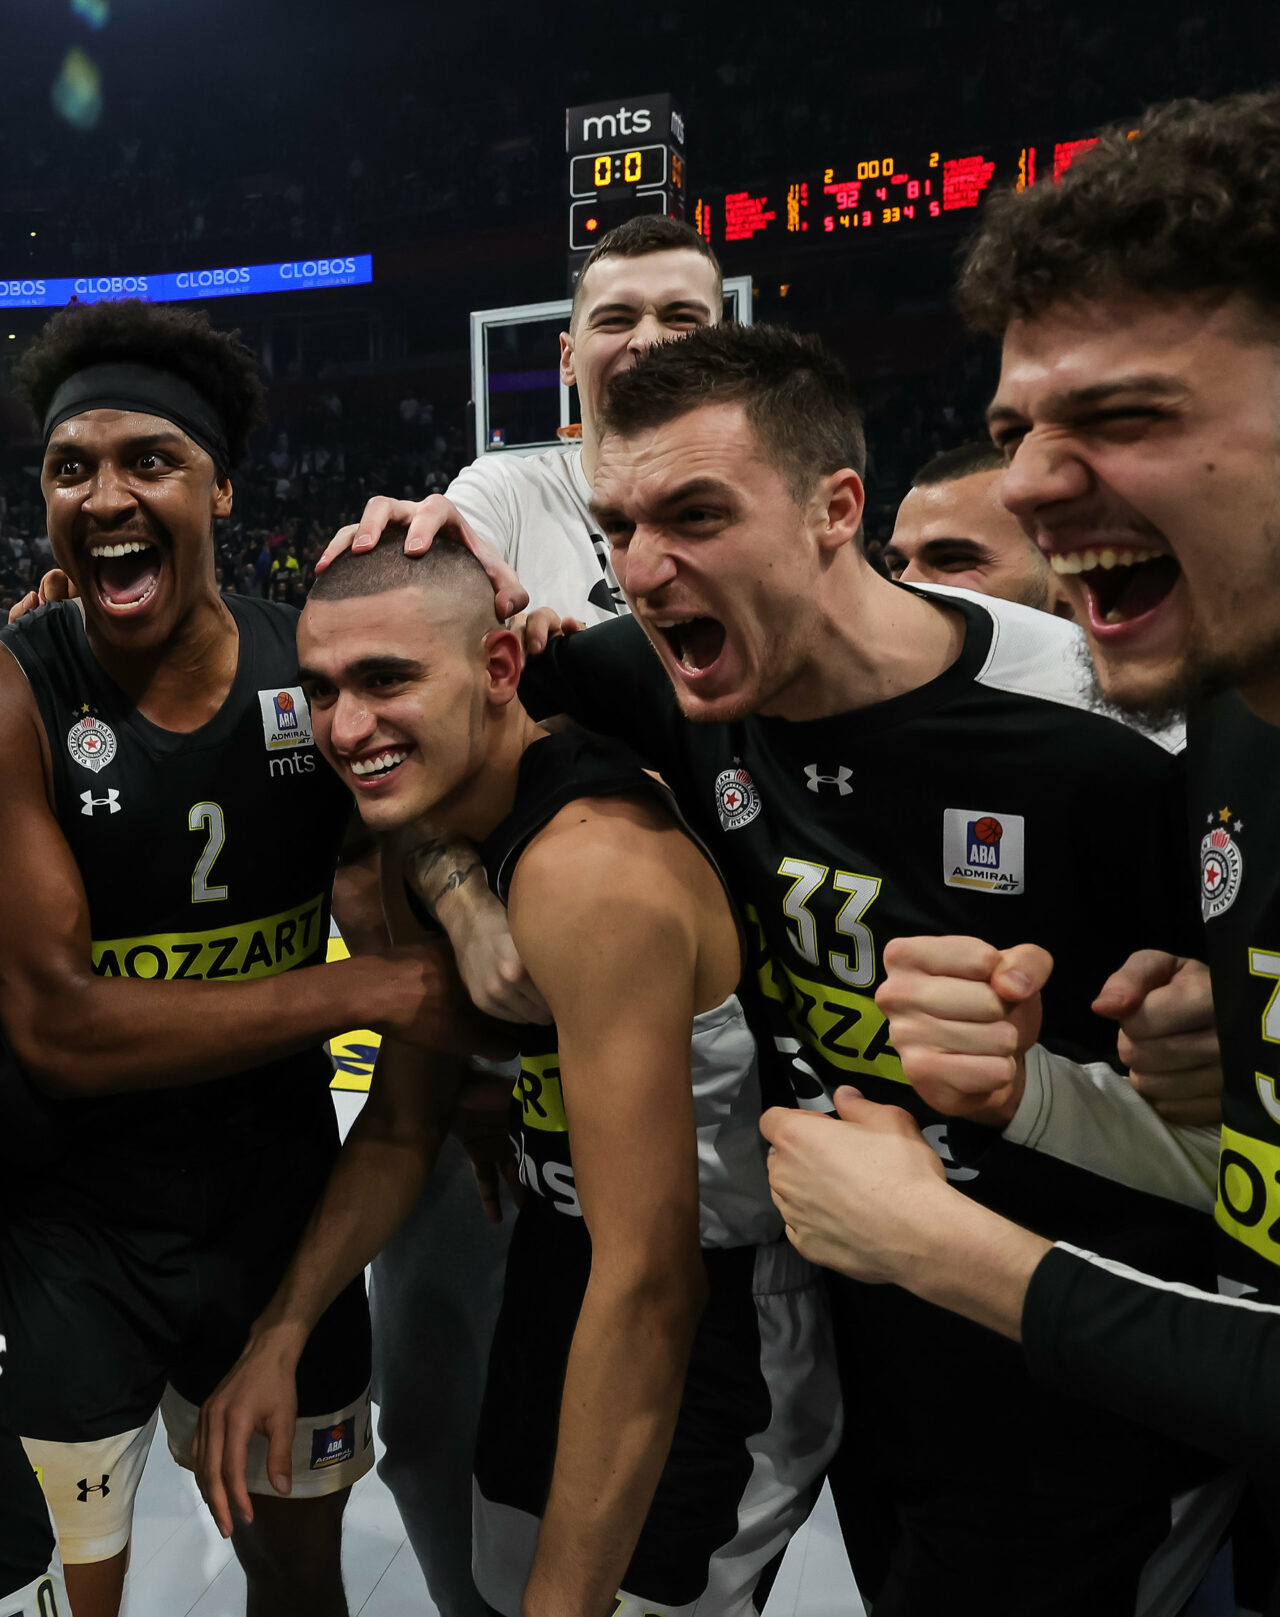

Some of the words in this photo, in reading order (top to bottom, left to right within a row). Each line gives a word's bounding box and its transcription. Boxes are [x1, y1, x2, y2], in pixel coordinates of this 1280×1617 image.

[583, 107, 652, 141] mts
[835, 190, 859, 210] 92
[176, 267, 251, 288] GLOBOS
[280, 258, 356, 279] GLOBOS
[74, 276, 148, 294] GLOBOS
[279, 712, 296, 728] ABA
[271, 729, 311, 742] ADMIRAL
[269, 752, 316, 777] mts
[188, 801, 229, 903] 2
[970, 844, 997, 865] ABA
[952, 866, 1019, 884] ADMIRAL
[777, 856, 882, 988] 33
